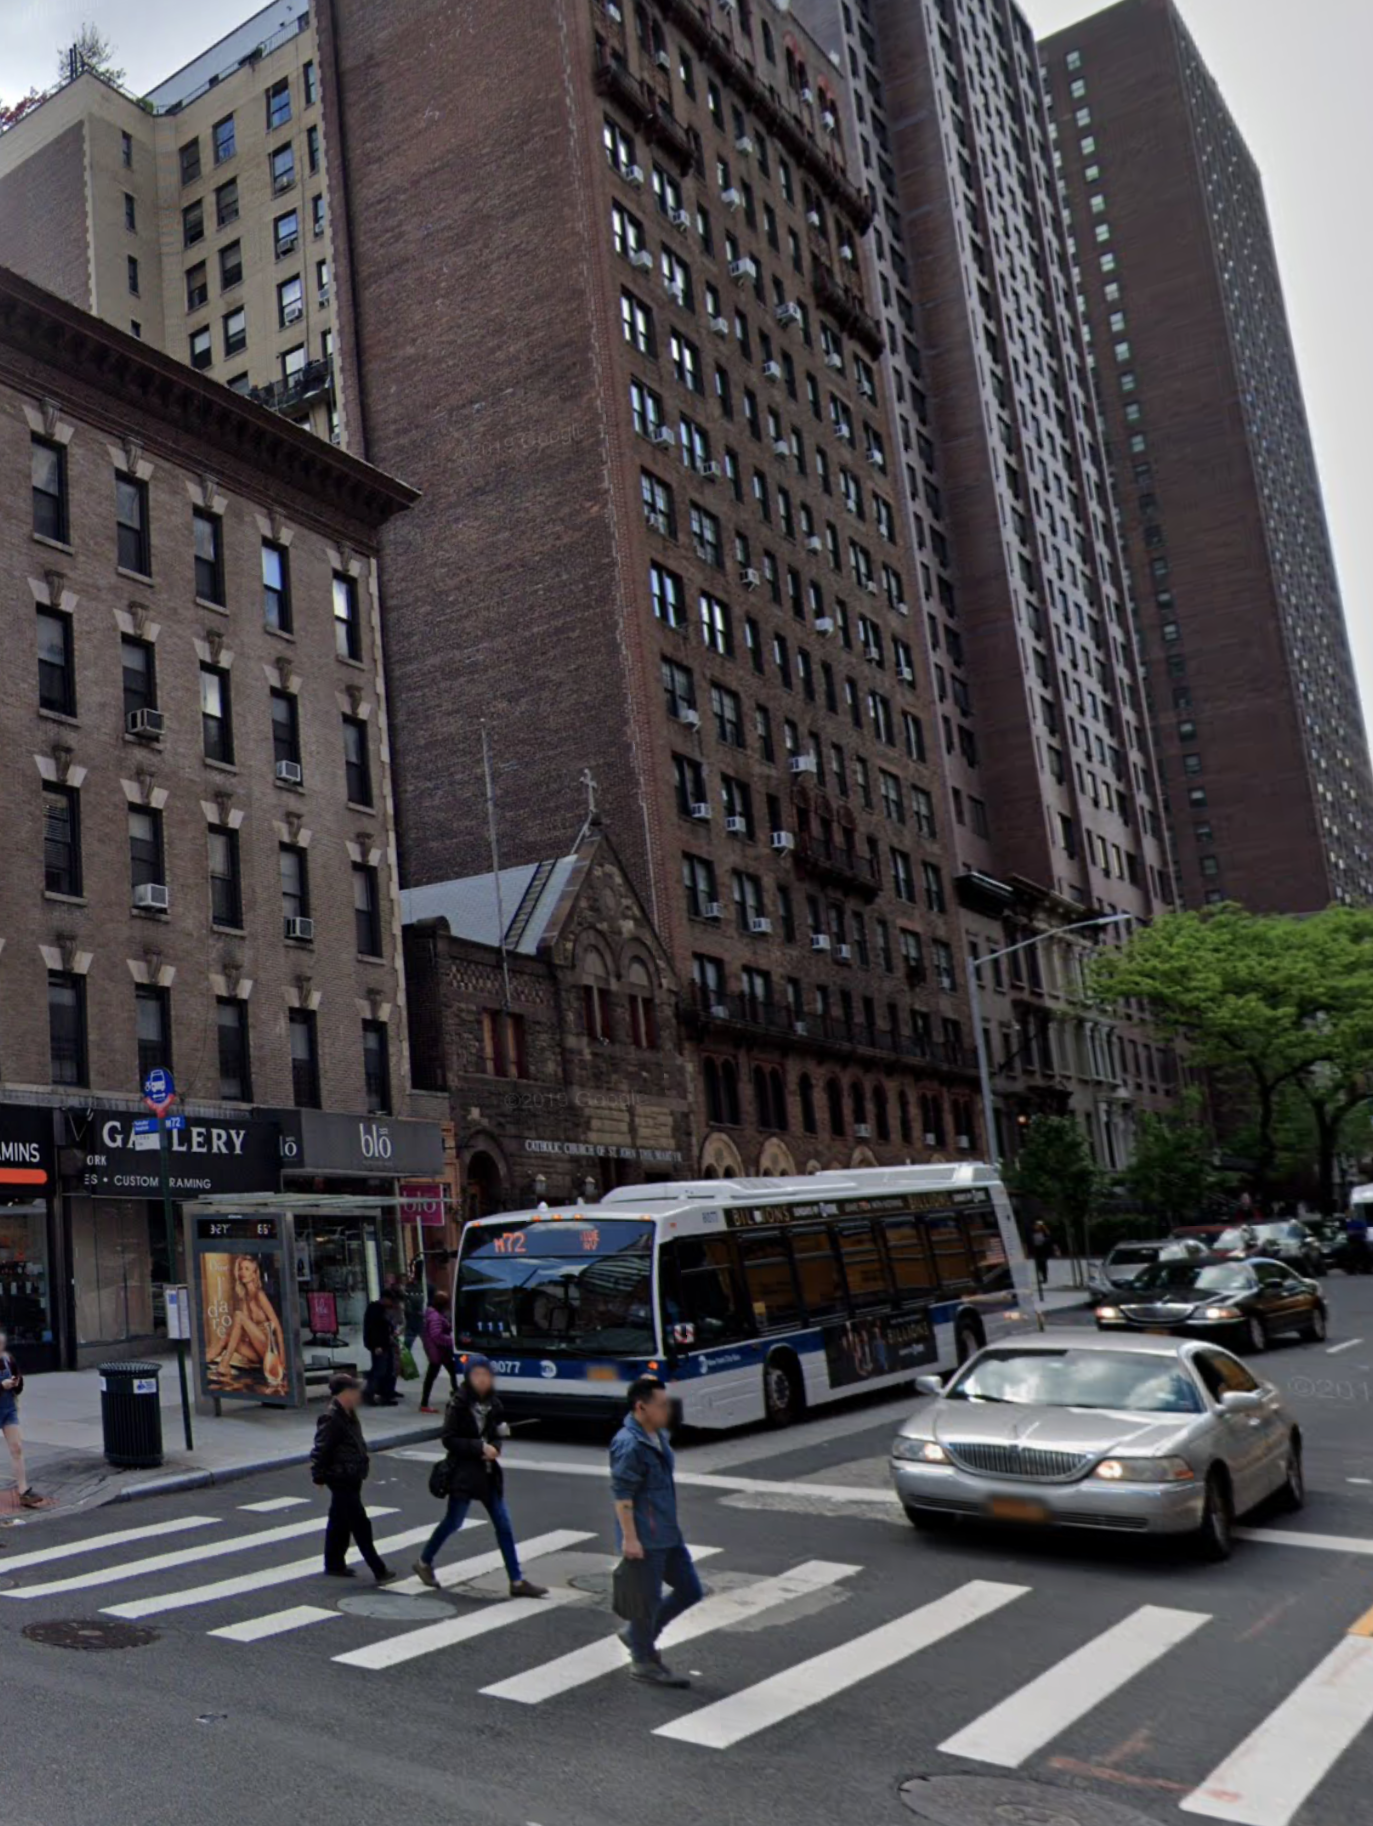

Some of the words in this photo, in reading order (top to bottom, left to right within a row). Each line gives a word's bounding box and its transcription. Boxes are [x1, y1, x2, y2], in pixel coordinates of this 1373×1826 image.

[102, 1121, 246, 1154] GLERY
[114, 1175, 159, 1187] CUSTOM
[168, 1177, 212, 1190] RAMING
[493, 1231, 526, 1254] M72
